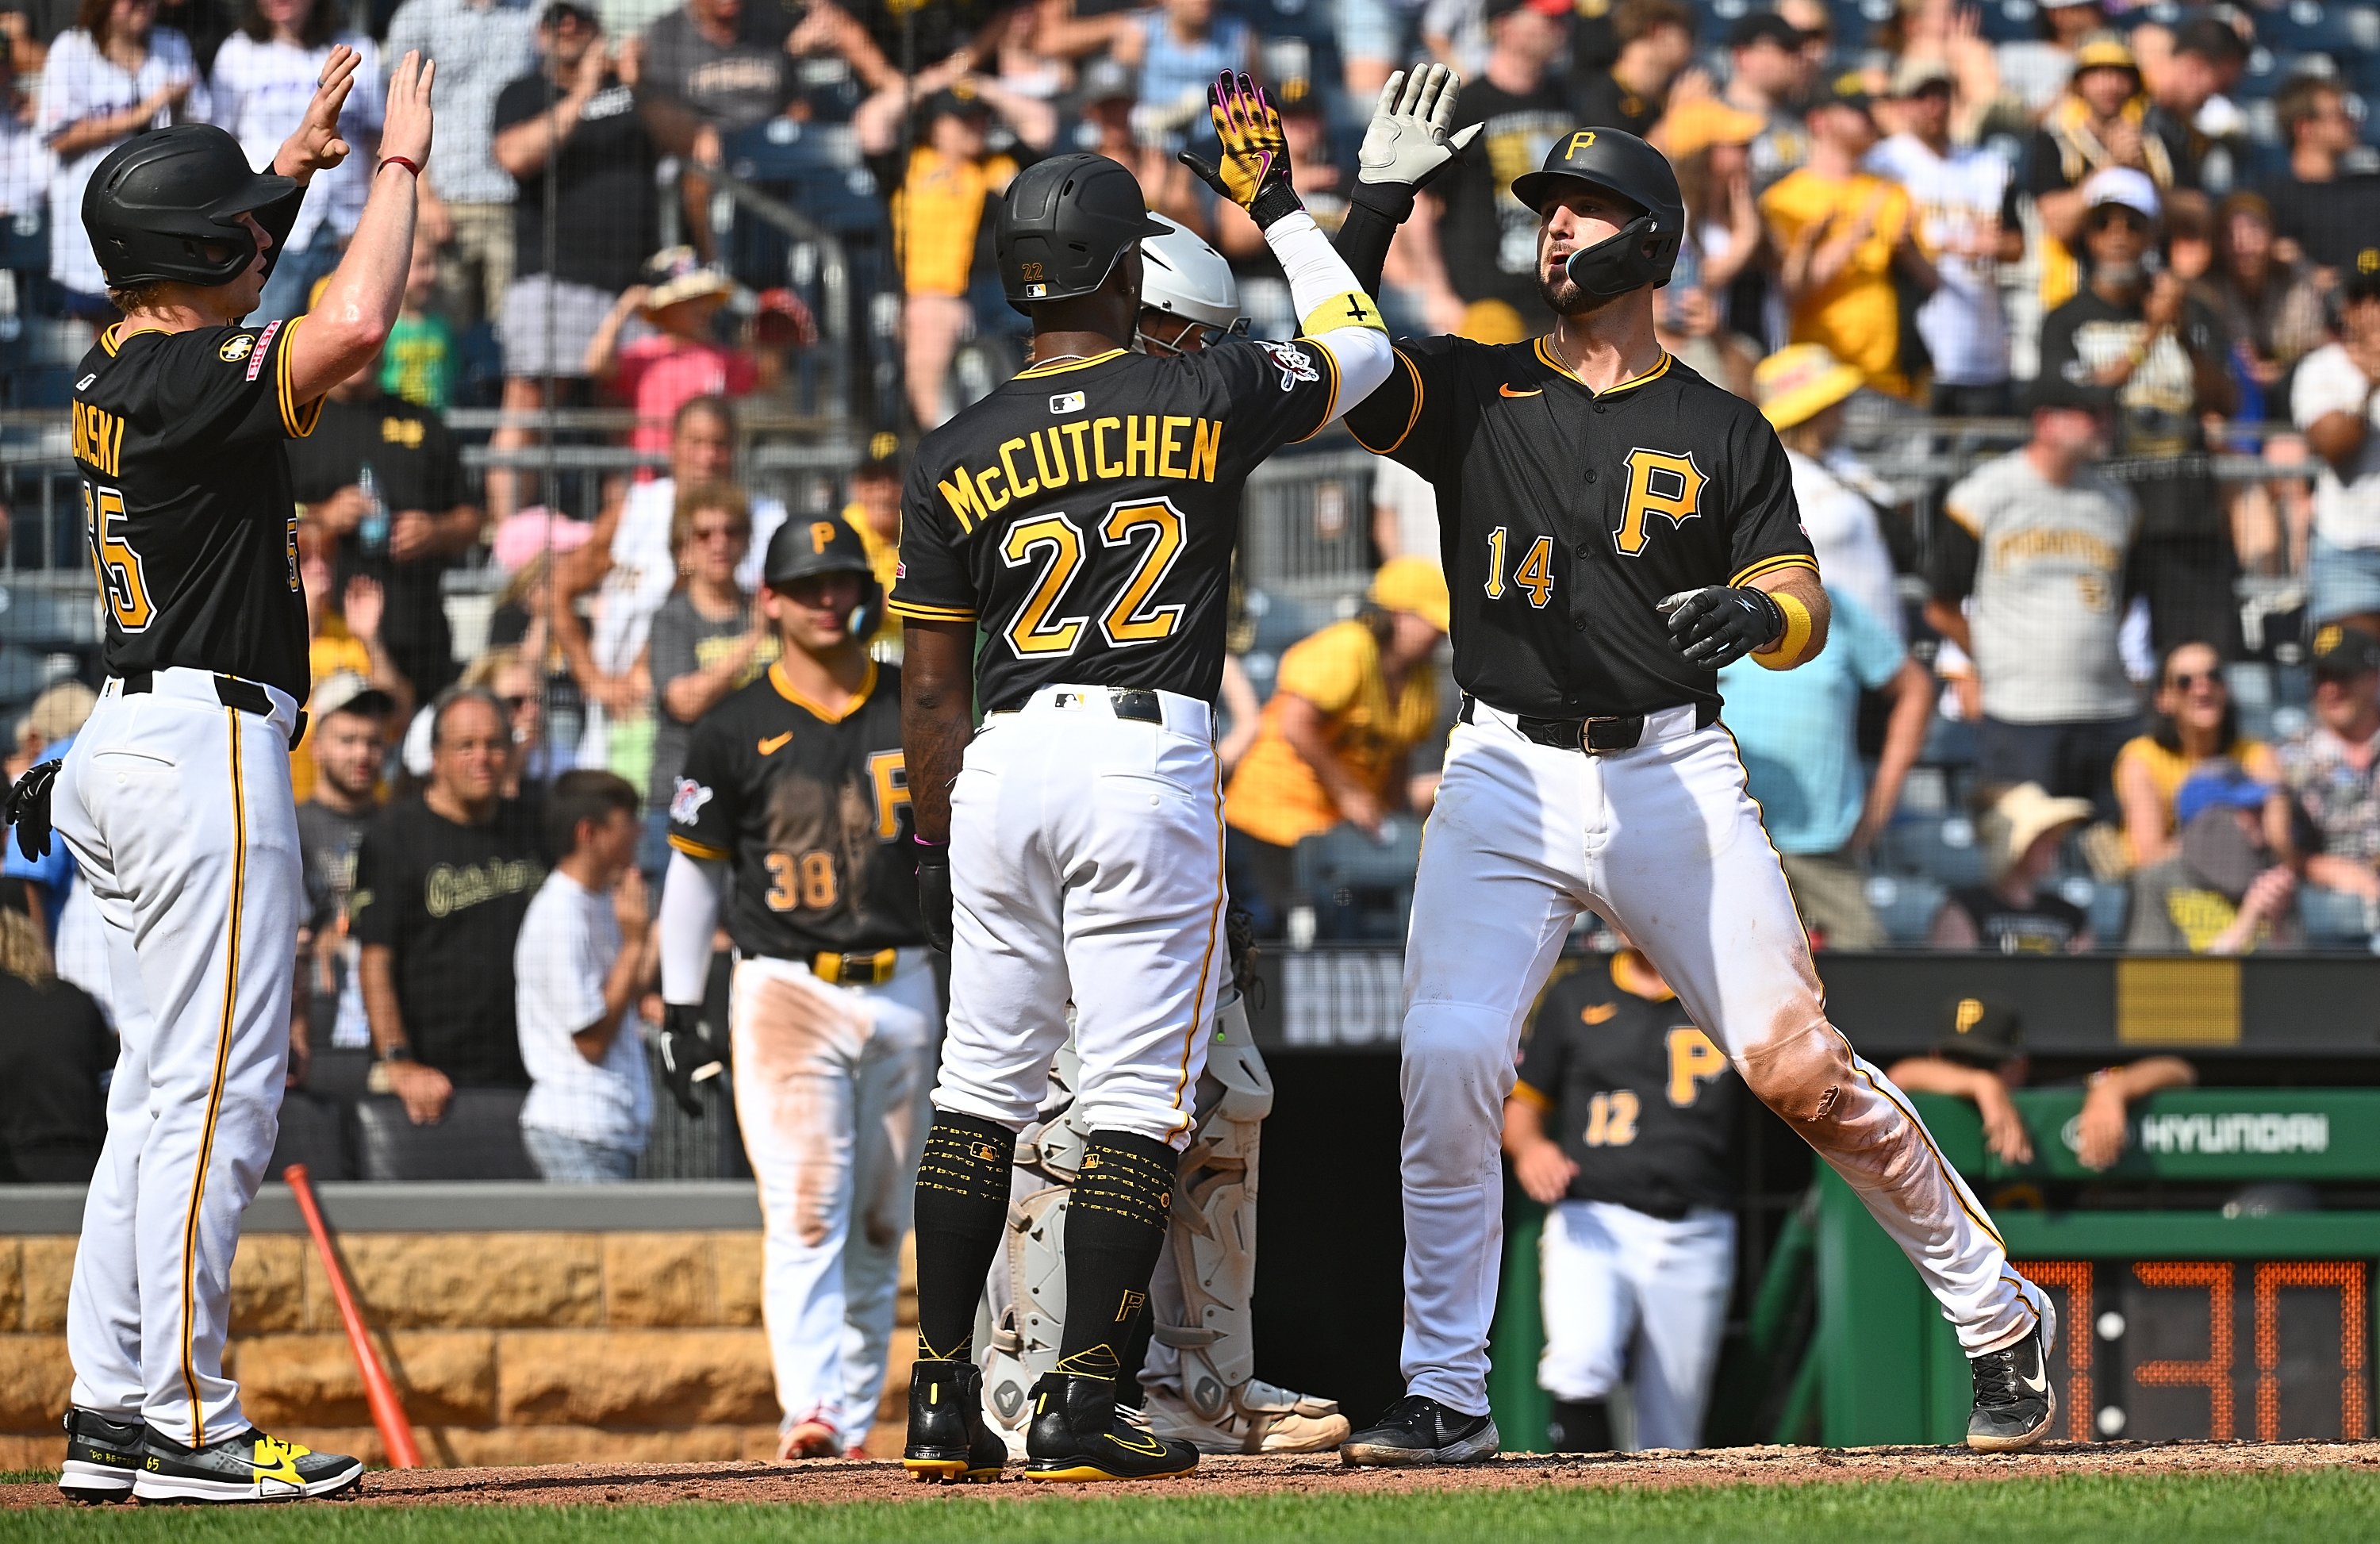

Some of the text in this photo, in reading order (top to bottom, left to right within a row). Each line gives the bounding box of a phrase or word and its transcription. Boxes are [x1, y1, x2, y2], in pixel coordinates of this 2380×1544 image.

[1565, 132, 1597, 160] P
[1022, 263, 1043, 282] 22
[249, 323, 279, 376] SHEETZ
[1612, 447, 1710, 557] P
[810, 521, 836, 555] P
[999, 495, 1188, 660] 22
[1484, 525, 1555, 609] 14
[764, 849, 837, 912] 38
[1956, 997, 1984, 1034] P
[1665, 1024, 1731, 1108] P
[1583, 1089, 1641, 1147] 12
[2143, 1113, 2330, 1154] HYUNDAI
[1115, 1289, 1146, 1322] P
[147, 1457, 159, 1471] 65
